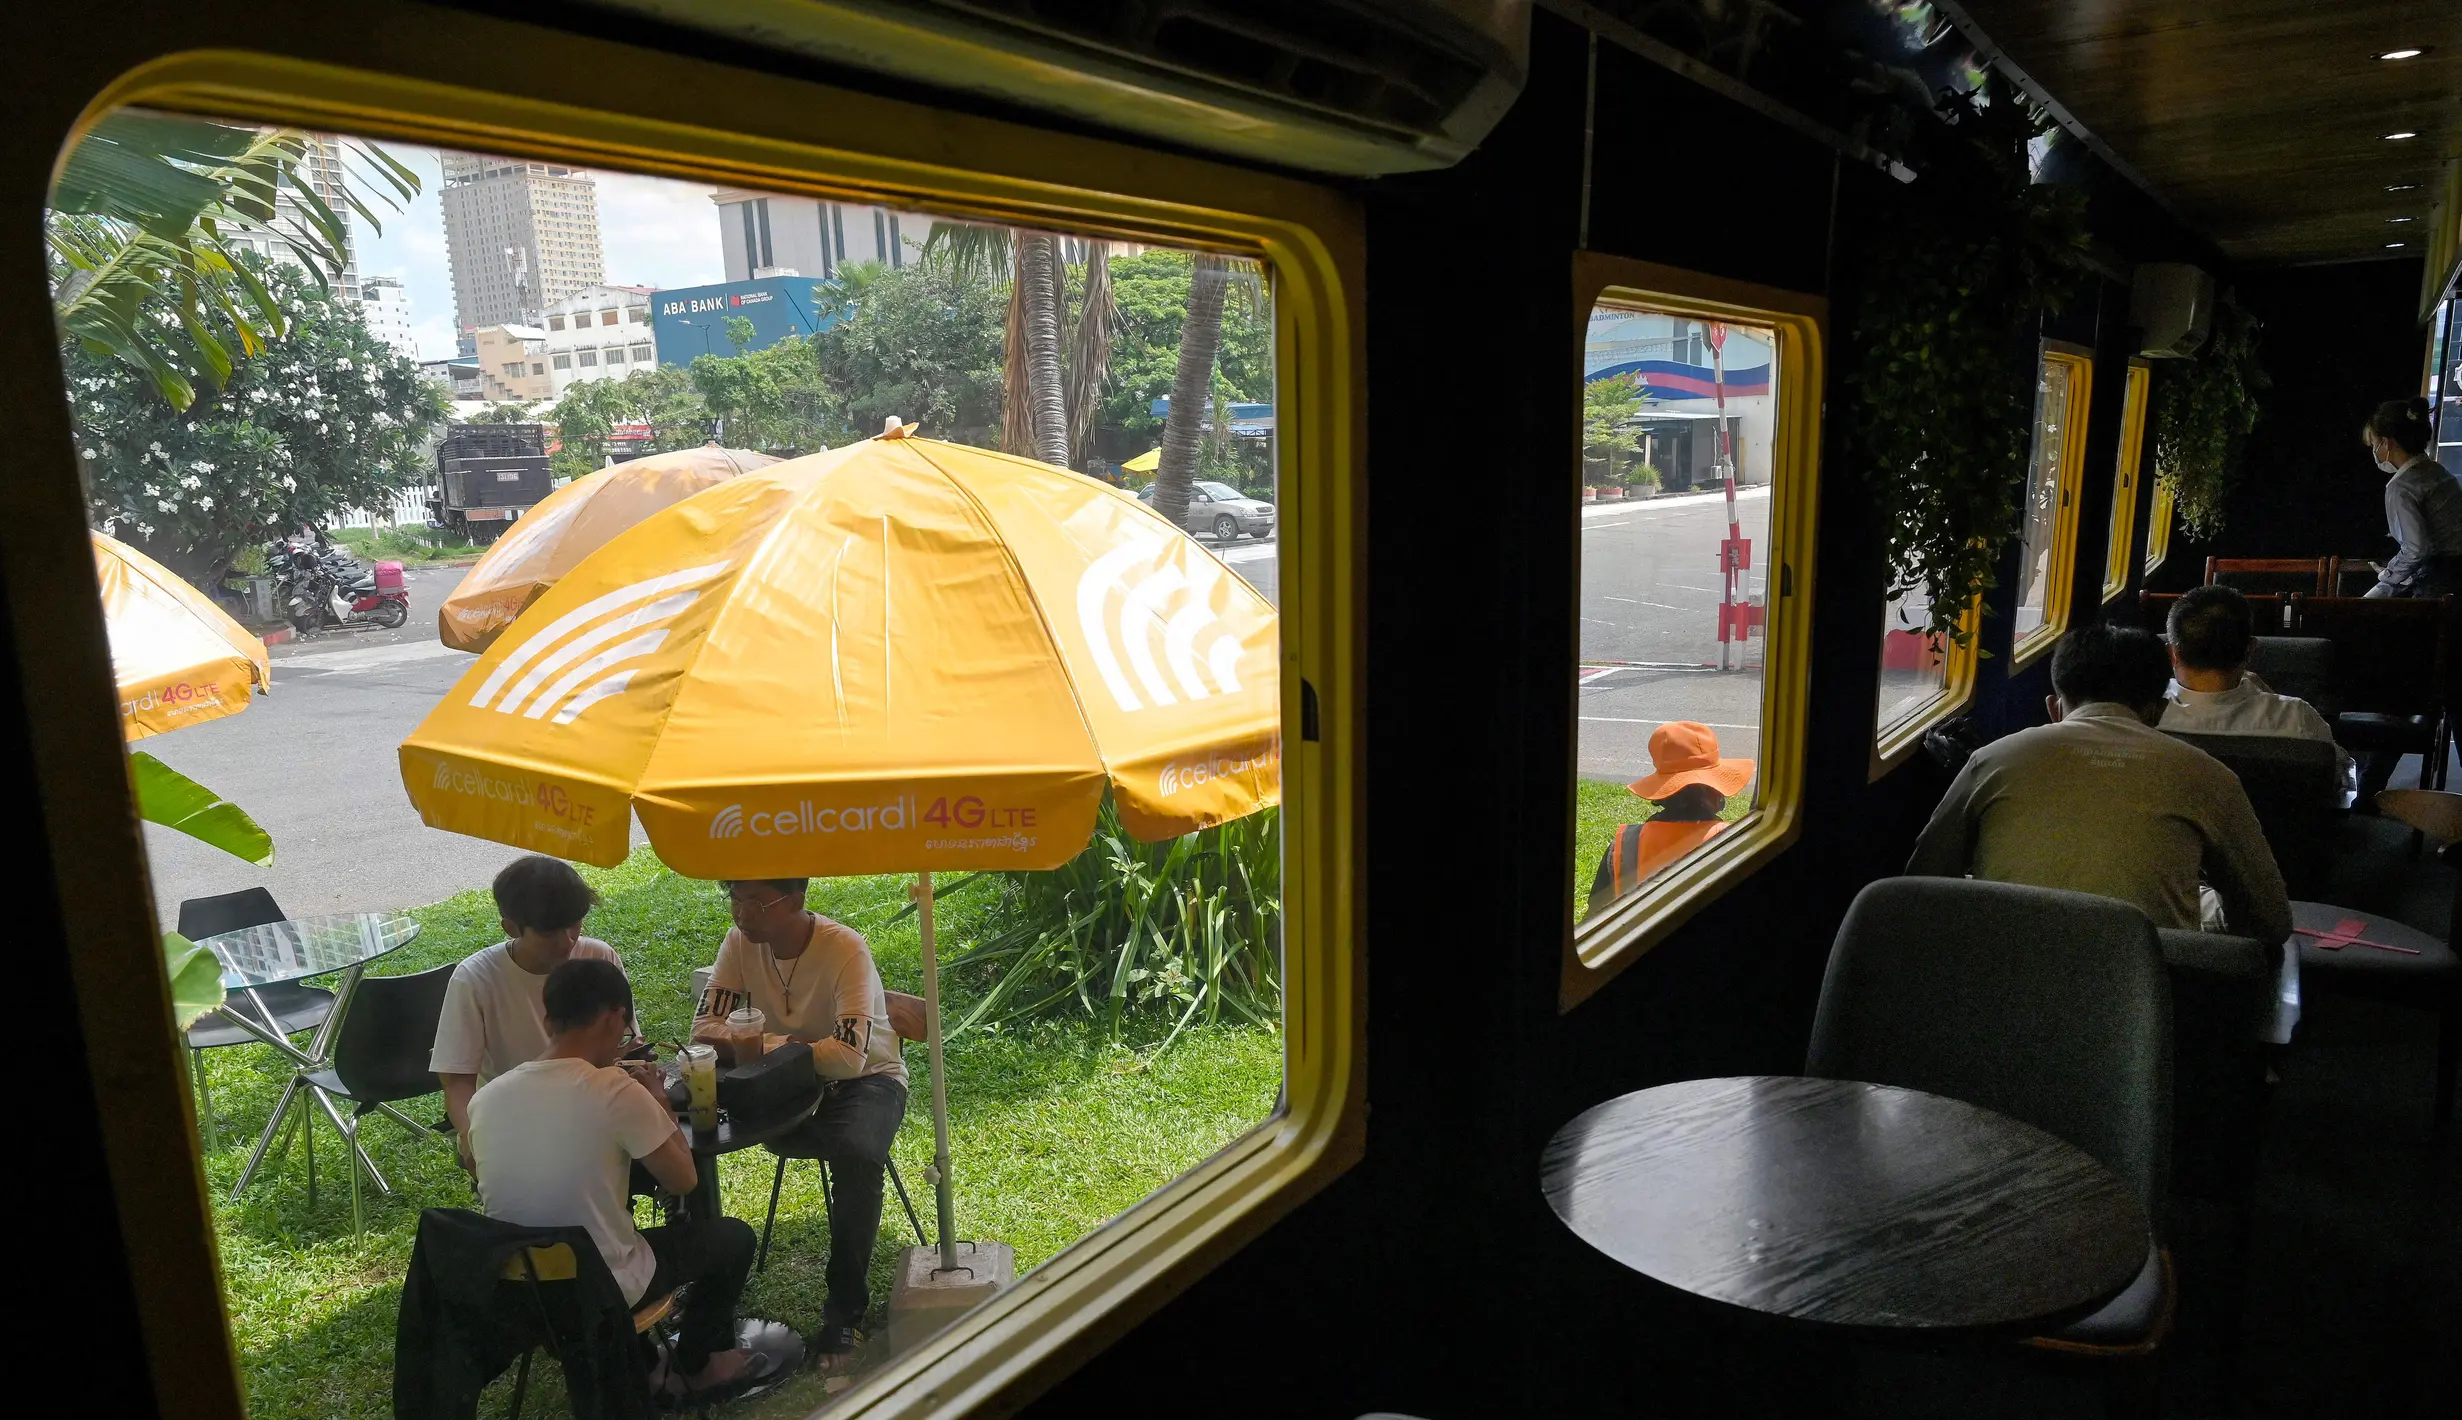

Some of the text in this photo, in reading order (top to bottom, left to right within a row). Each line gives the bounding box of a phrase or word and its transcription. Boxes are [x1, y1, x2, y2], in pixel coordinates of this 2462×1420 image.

[663, 296, 724, 316] ABA BANK
[161, 683, 193, 705] 4G
[194, 682, 221, 698] LTE
[452, 767, 596, 827] cellcard 4G LTE
[750, 795, 1037, 836] cellcard 4G LTE
